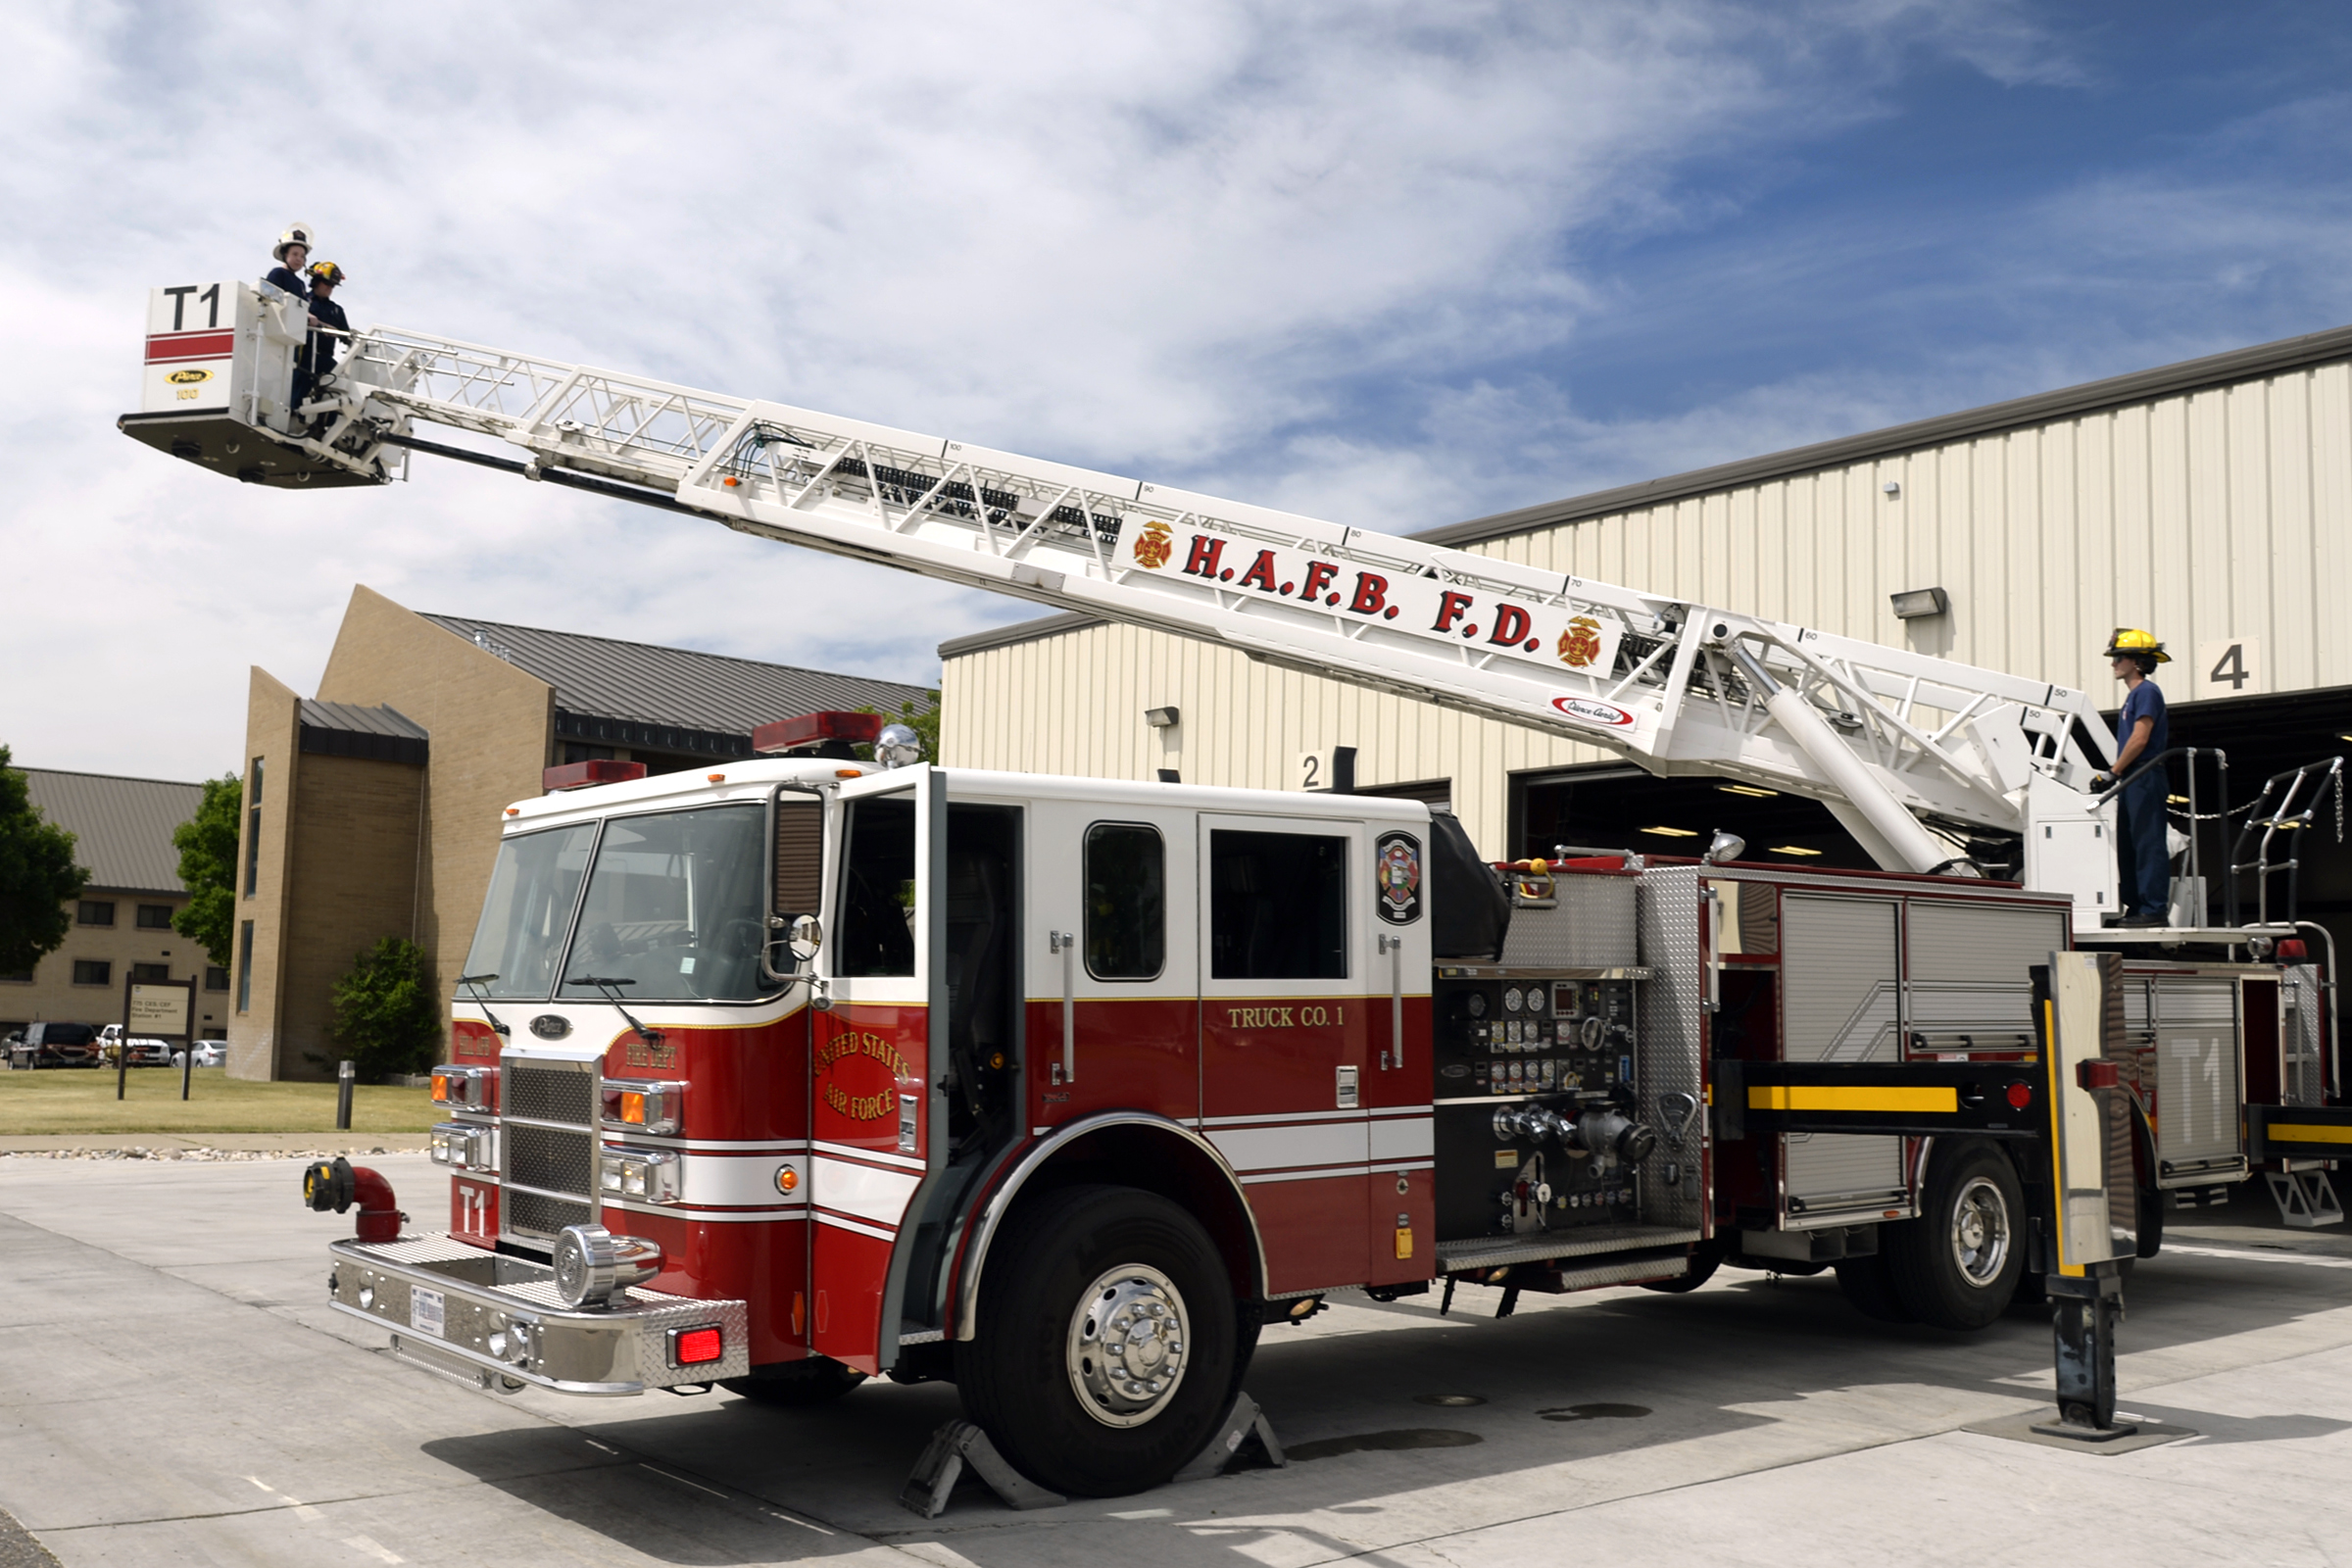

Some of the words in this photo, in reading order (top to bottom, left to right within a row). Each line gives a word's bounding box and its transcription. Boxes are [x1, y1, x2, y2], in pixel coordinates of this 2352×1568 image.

[164, 283, 220, 331] T1
[176, 388, 199, 400] 100
[1350, 529, 1361, 538] 80
[1182, 534, 1399, 620] H.A.F.B.
[1430, 590, 1540, 654] F.D.
[1571, 578, 1583, 587] 70
[1805, 631, 1818, 640] 60
[2210, 643, 2249, 690] 4
[2054, 688, 2068, 698] 50
[2029, 710, 2041, 718] 50
[1302, 755, 1319, 788] 2
[1227, 1006, 1295, 1028] TRUCK
[1300, 1005, 1331, 1026] CO.
[1337, 1005, 1345, 1025] 1
[812, 1031, 858, 1077] UNITED
[861, 1032, 911, 1085] STATES
[823, 1082, 847, 1116] AIR
[850, 1087, 896, 1121] FORCE
[2171, 1038, 2222, 1144] T1
[460, 1185, 485, 1238] T1
